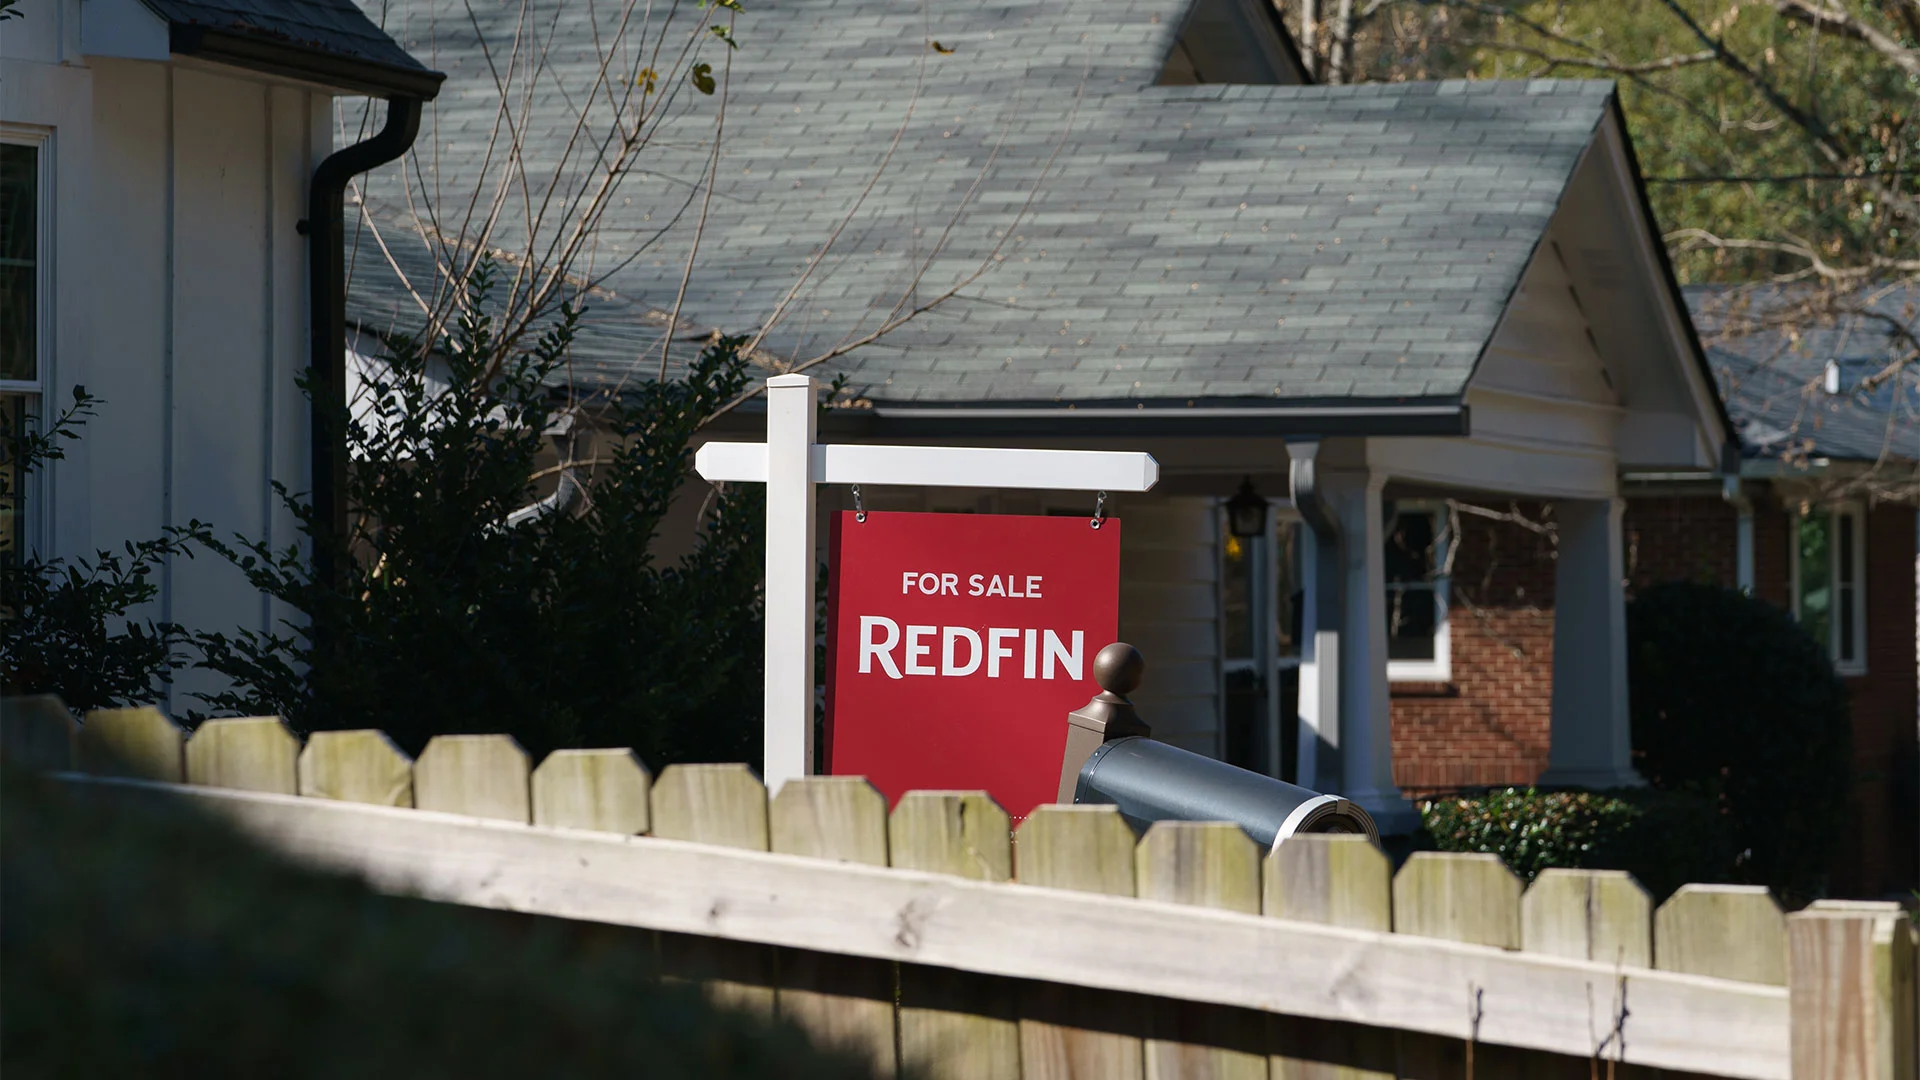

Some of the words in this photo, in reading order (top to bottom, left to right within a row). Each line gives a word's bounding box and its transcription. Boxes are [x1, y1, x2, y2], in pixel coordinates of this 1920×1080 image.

[902, 571, 959, 596] FOR
[968, 573, 1043, 599] SALE
[858, 615, 1085, 681] REDFIN
